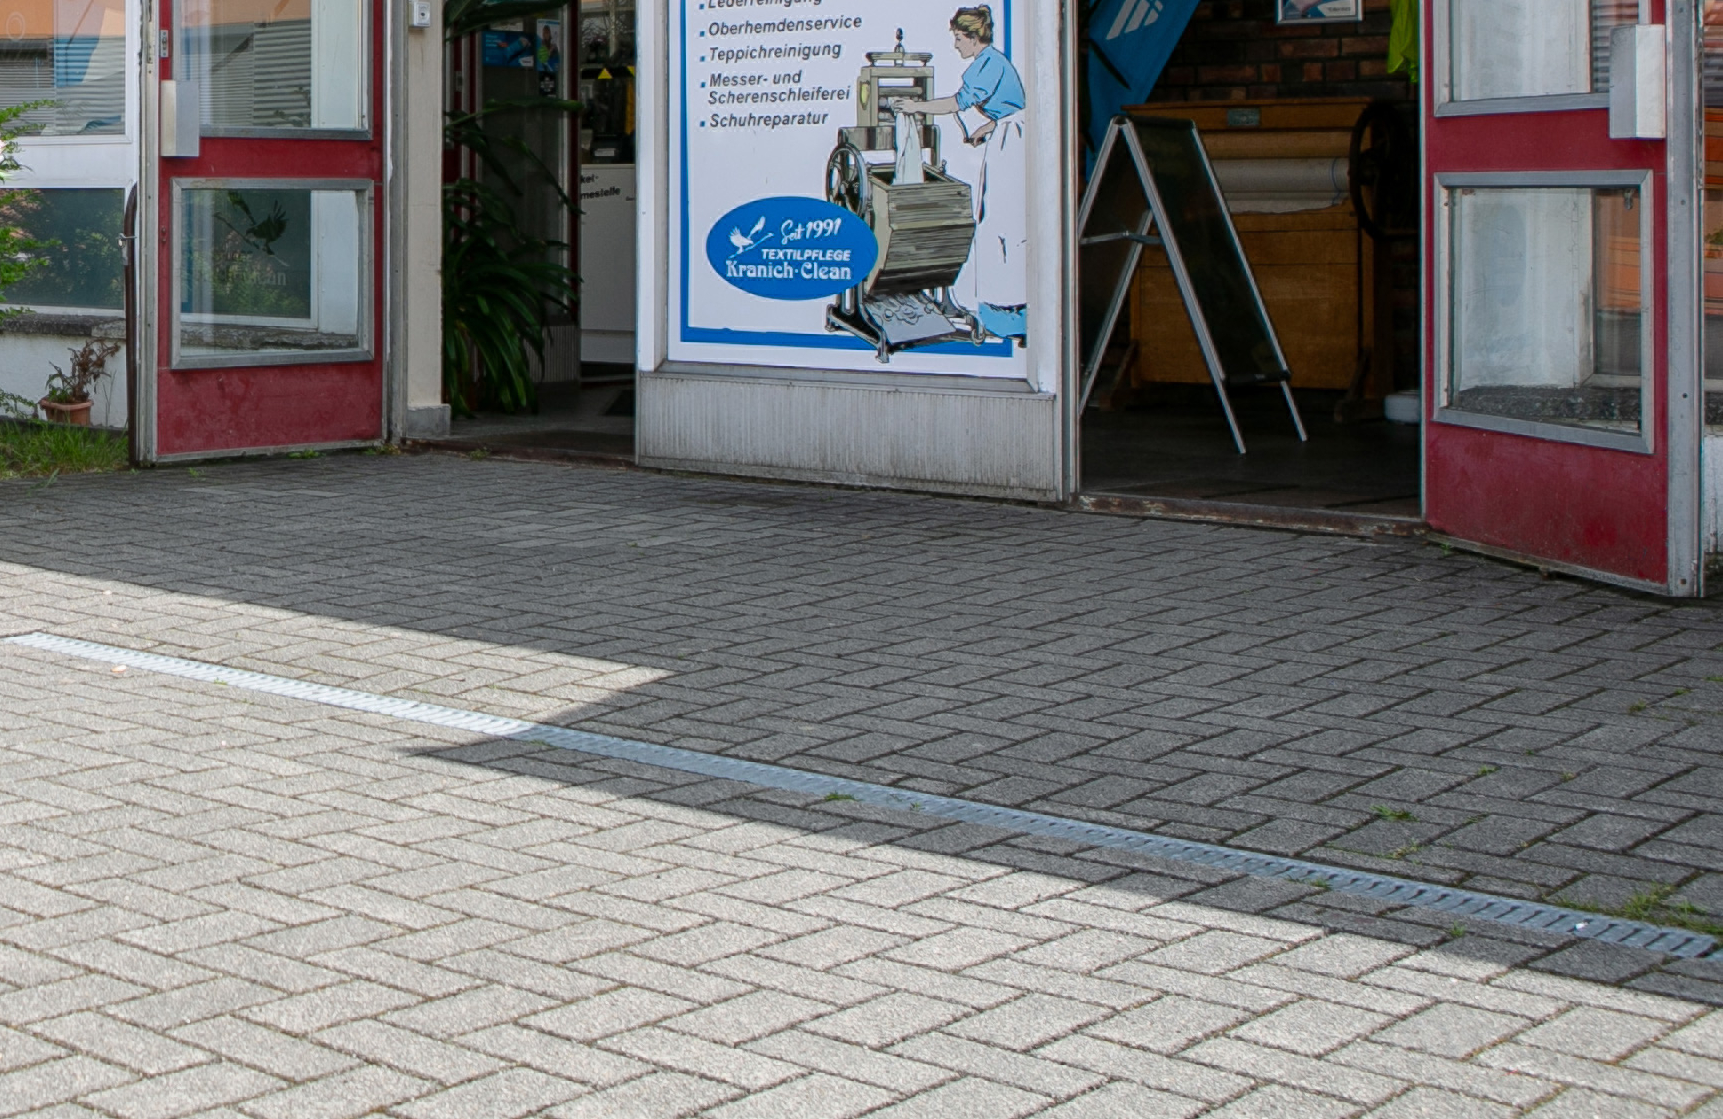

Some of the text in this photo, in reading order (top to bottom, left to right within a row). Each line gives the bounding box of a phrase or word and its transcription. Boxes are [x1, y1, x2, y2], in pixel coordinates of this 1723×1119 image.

[708, 15, 862, 37] Oberhemdenservice
[709, 43, 842, 64] Teppichreinigung
[709, 69, 803, 87] Messer- und
[707, 85, 851, 105] Scherenschleiferei
[709, 111, 829, 130] Schuhreparatur
[780, 217, 842, 245] Seit 1991
[761, 248, 852, 262] TEXTILPFLEGE
